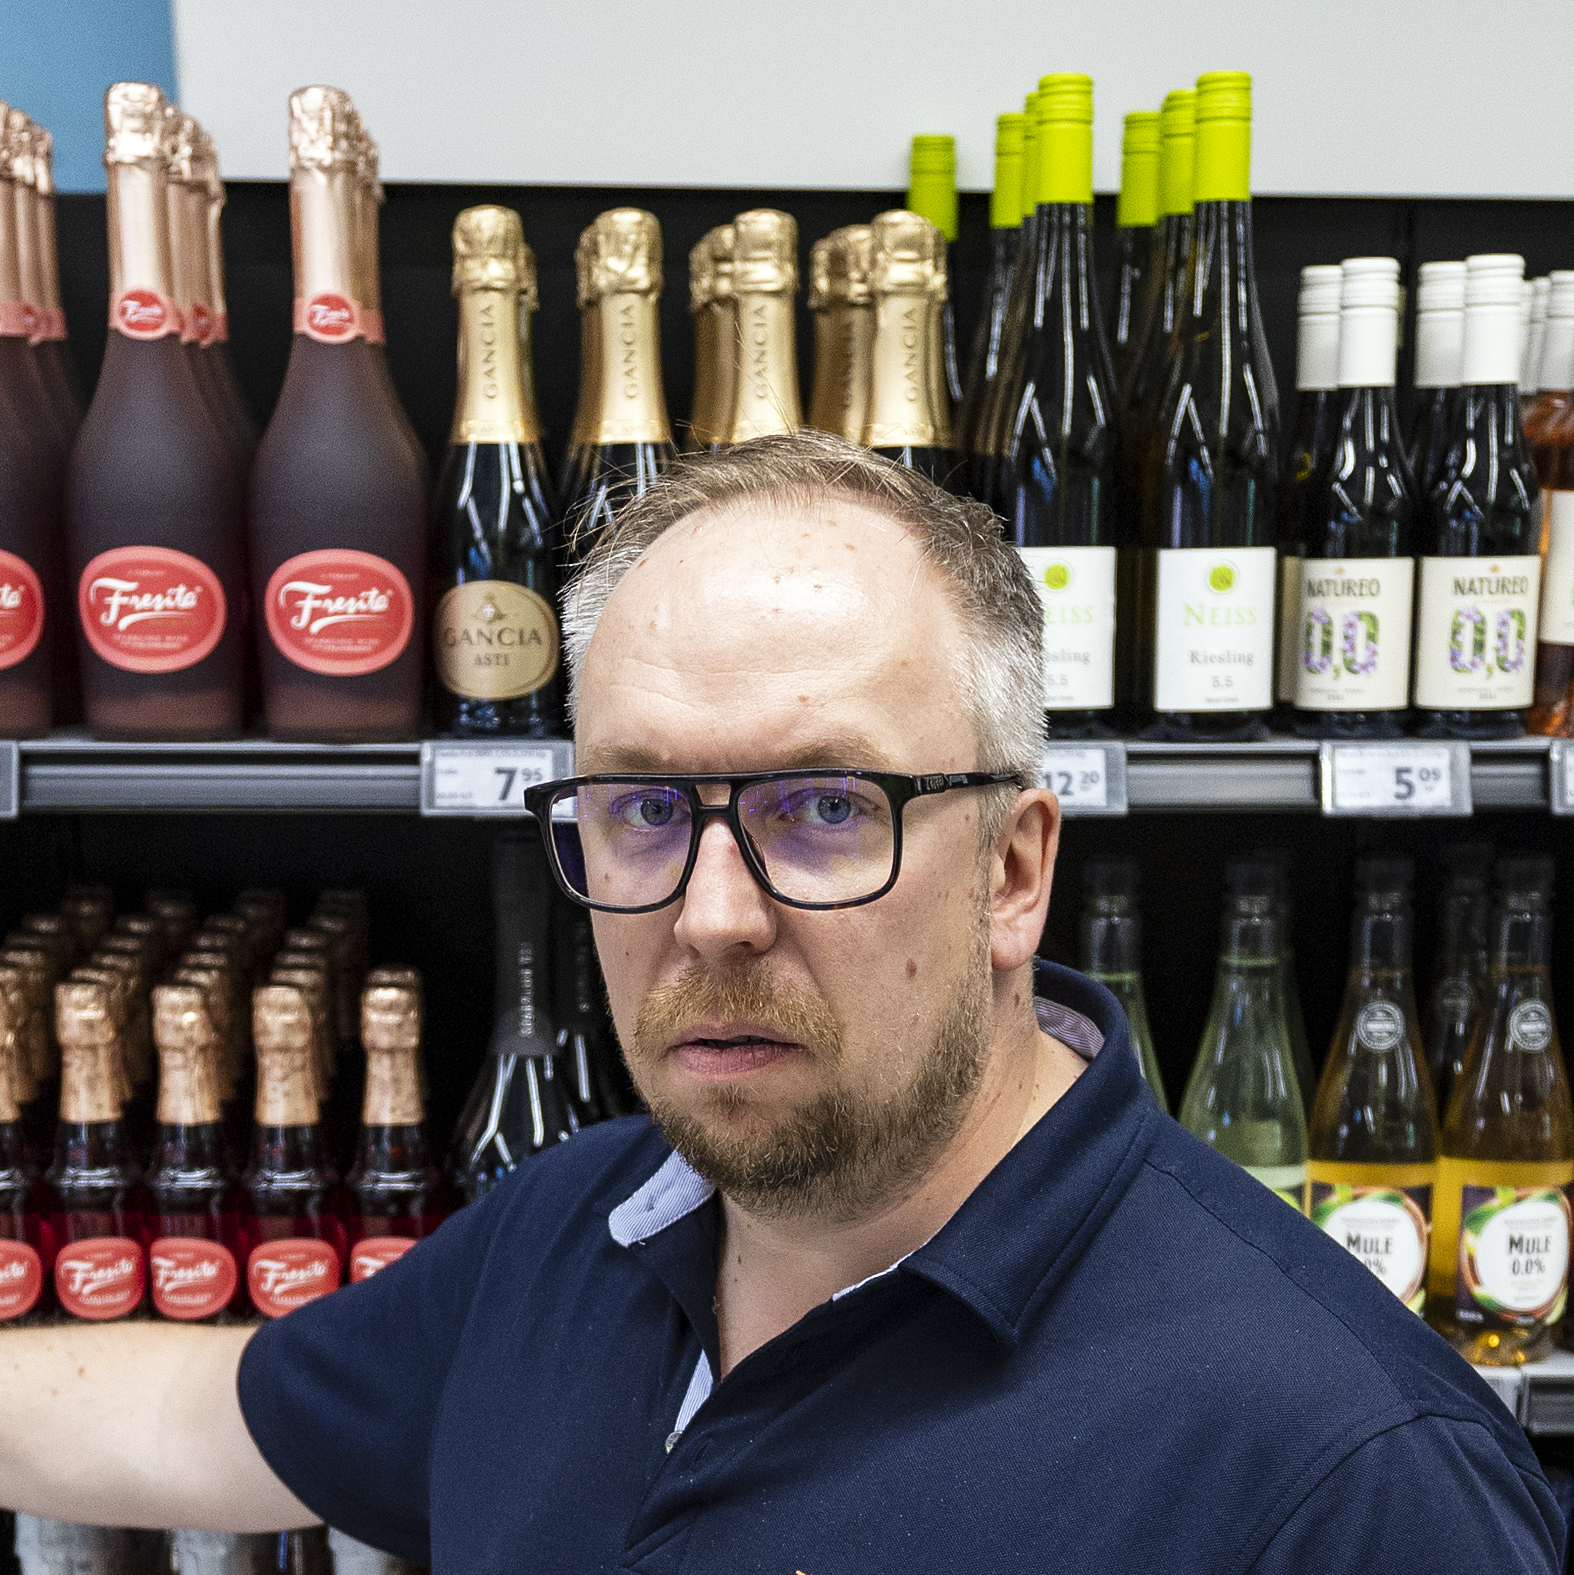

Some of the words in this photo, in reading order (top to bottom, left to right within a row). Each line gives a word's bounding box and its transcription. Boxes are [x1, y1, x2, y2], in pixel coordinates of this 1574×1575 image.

[482, 305, 498, 399] GANCIA
[621, 304, 639, 400] GANCIA
[752, 305, 769, 400] GANCIA
[904, 307, 920, 402] GANCIA
[90, 577, 200, 627] Fresita
[1307, 577, 1380, 598] NATUREO
[1453, 577, 1528, 597] NATUREO
[281, 581, 391, 628] Fresita
[1182, 604, 1257, 626] NEISS
[445, 627, 542, 648] GANCIA
[474, 654, 509, 666] ASTI
[495, 768, 518, 801] 7
[1394, 767, 1415, 800] 5
[1509, 1233, 1551, 1255] MULE
